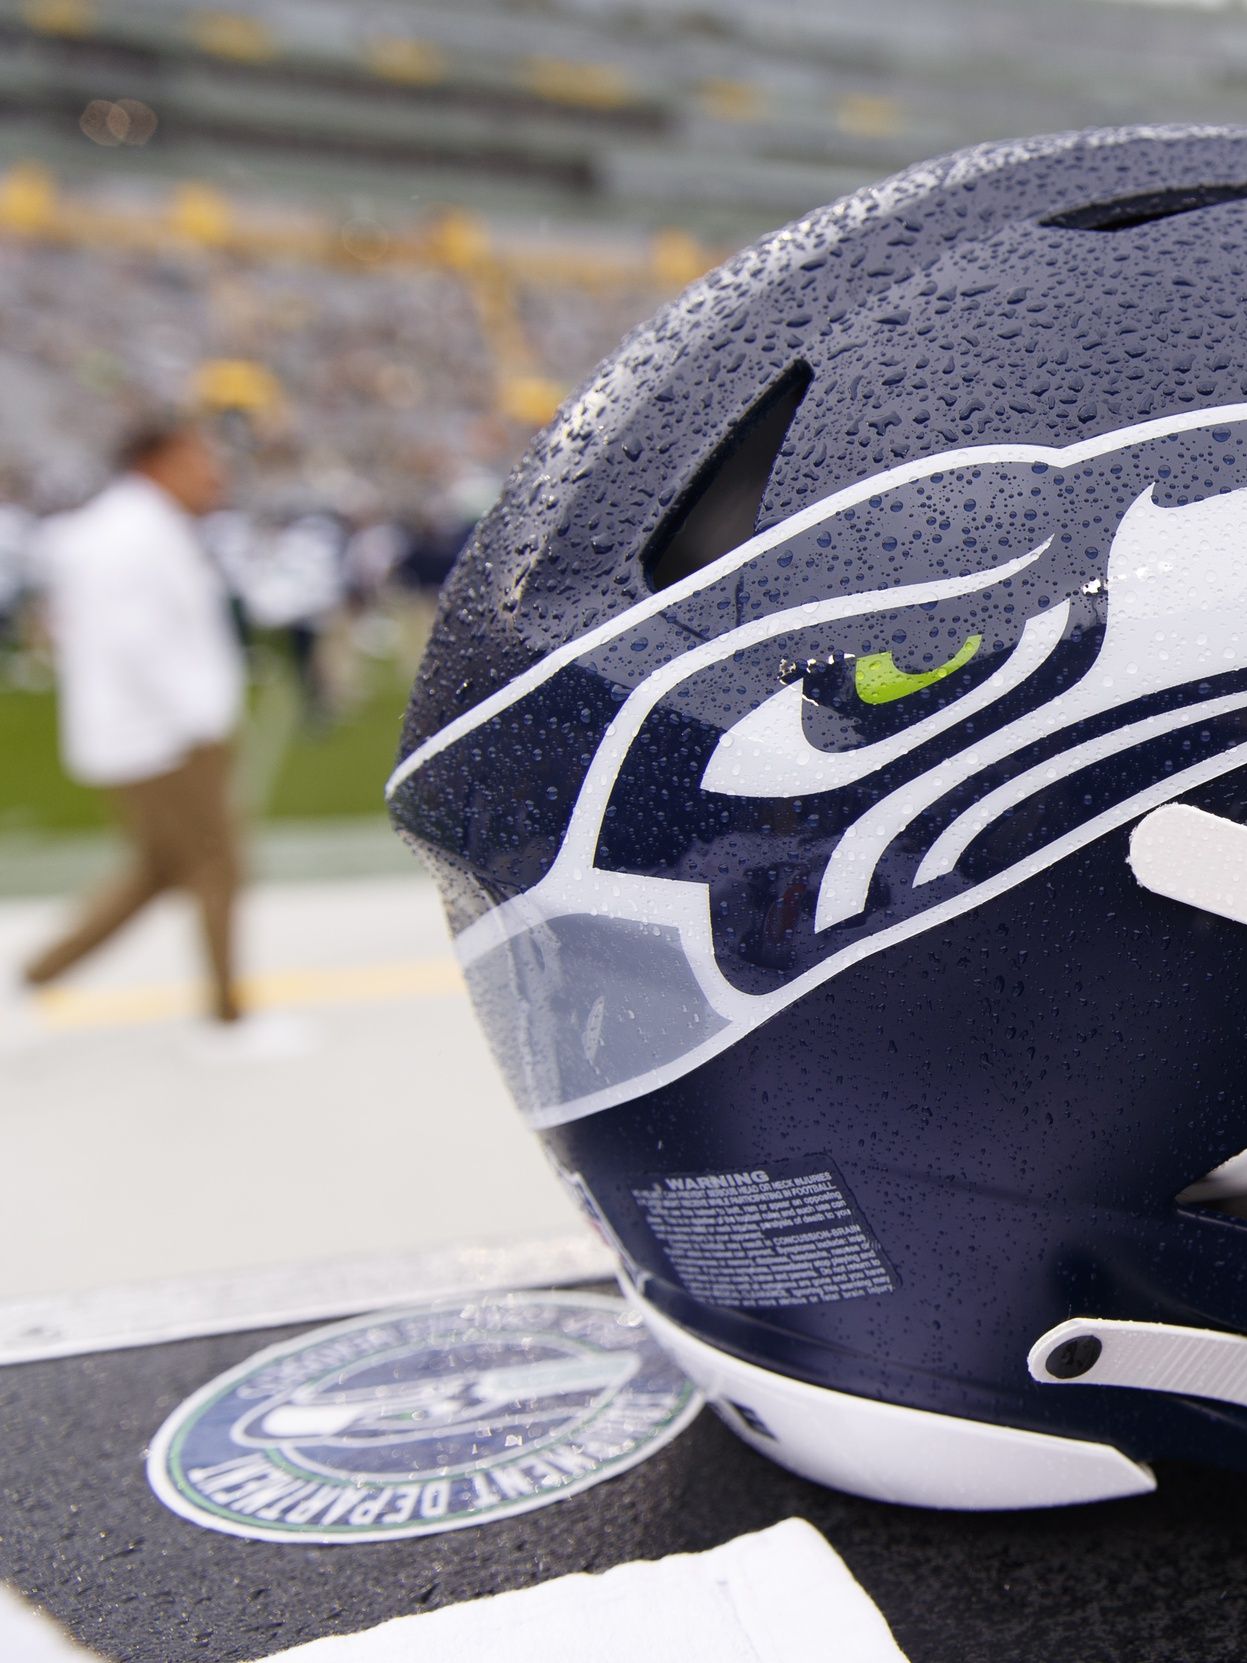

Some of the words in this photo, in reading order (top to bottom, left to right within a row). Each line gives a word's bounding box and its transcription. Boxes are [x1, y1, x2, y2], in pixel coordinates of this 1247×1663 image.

[665, 1170, 770, 1190] WARNING
[759, 1183, 772, 1191] OR
[772, 1180, 794, 1189] NECK
[803, 1191, 842, 1204] opposing
[795, 1206, 815, 1214] such
[835, 1208, 852, 1218] you
[189, 1453, 451, 1526] DEPARTMENT
